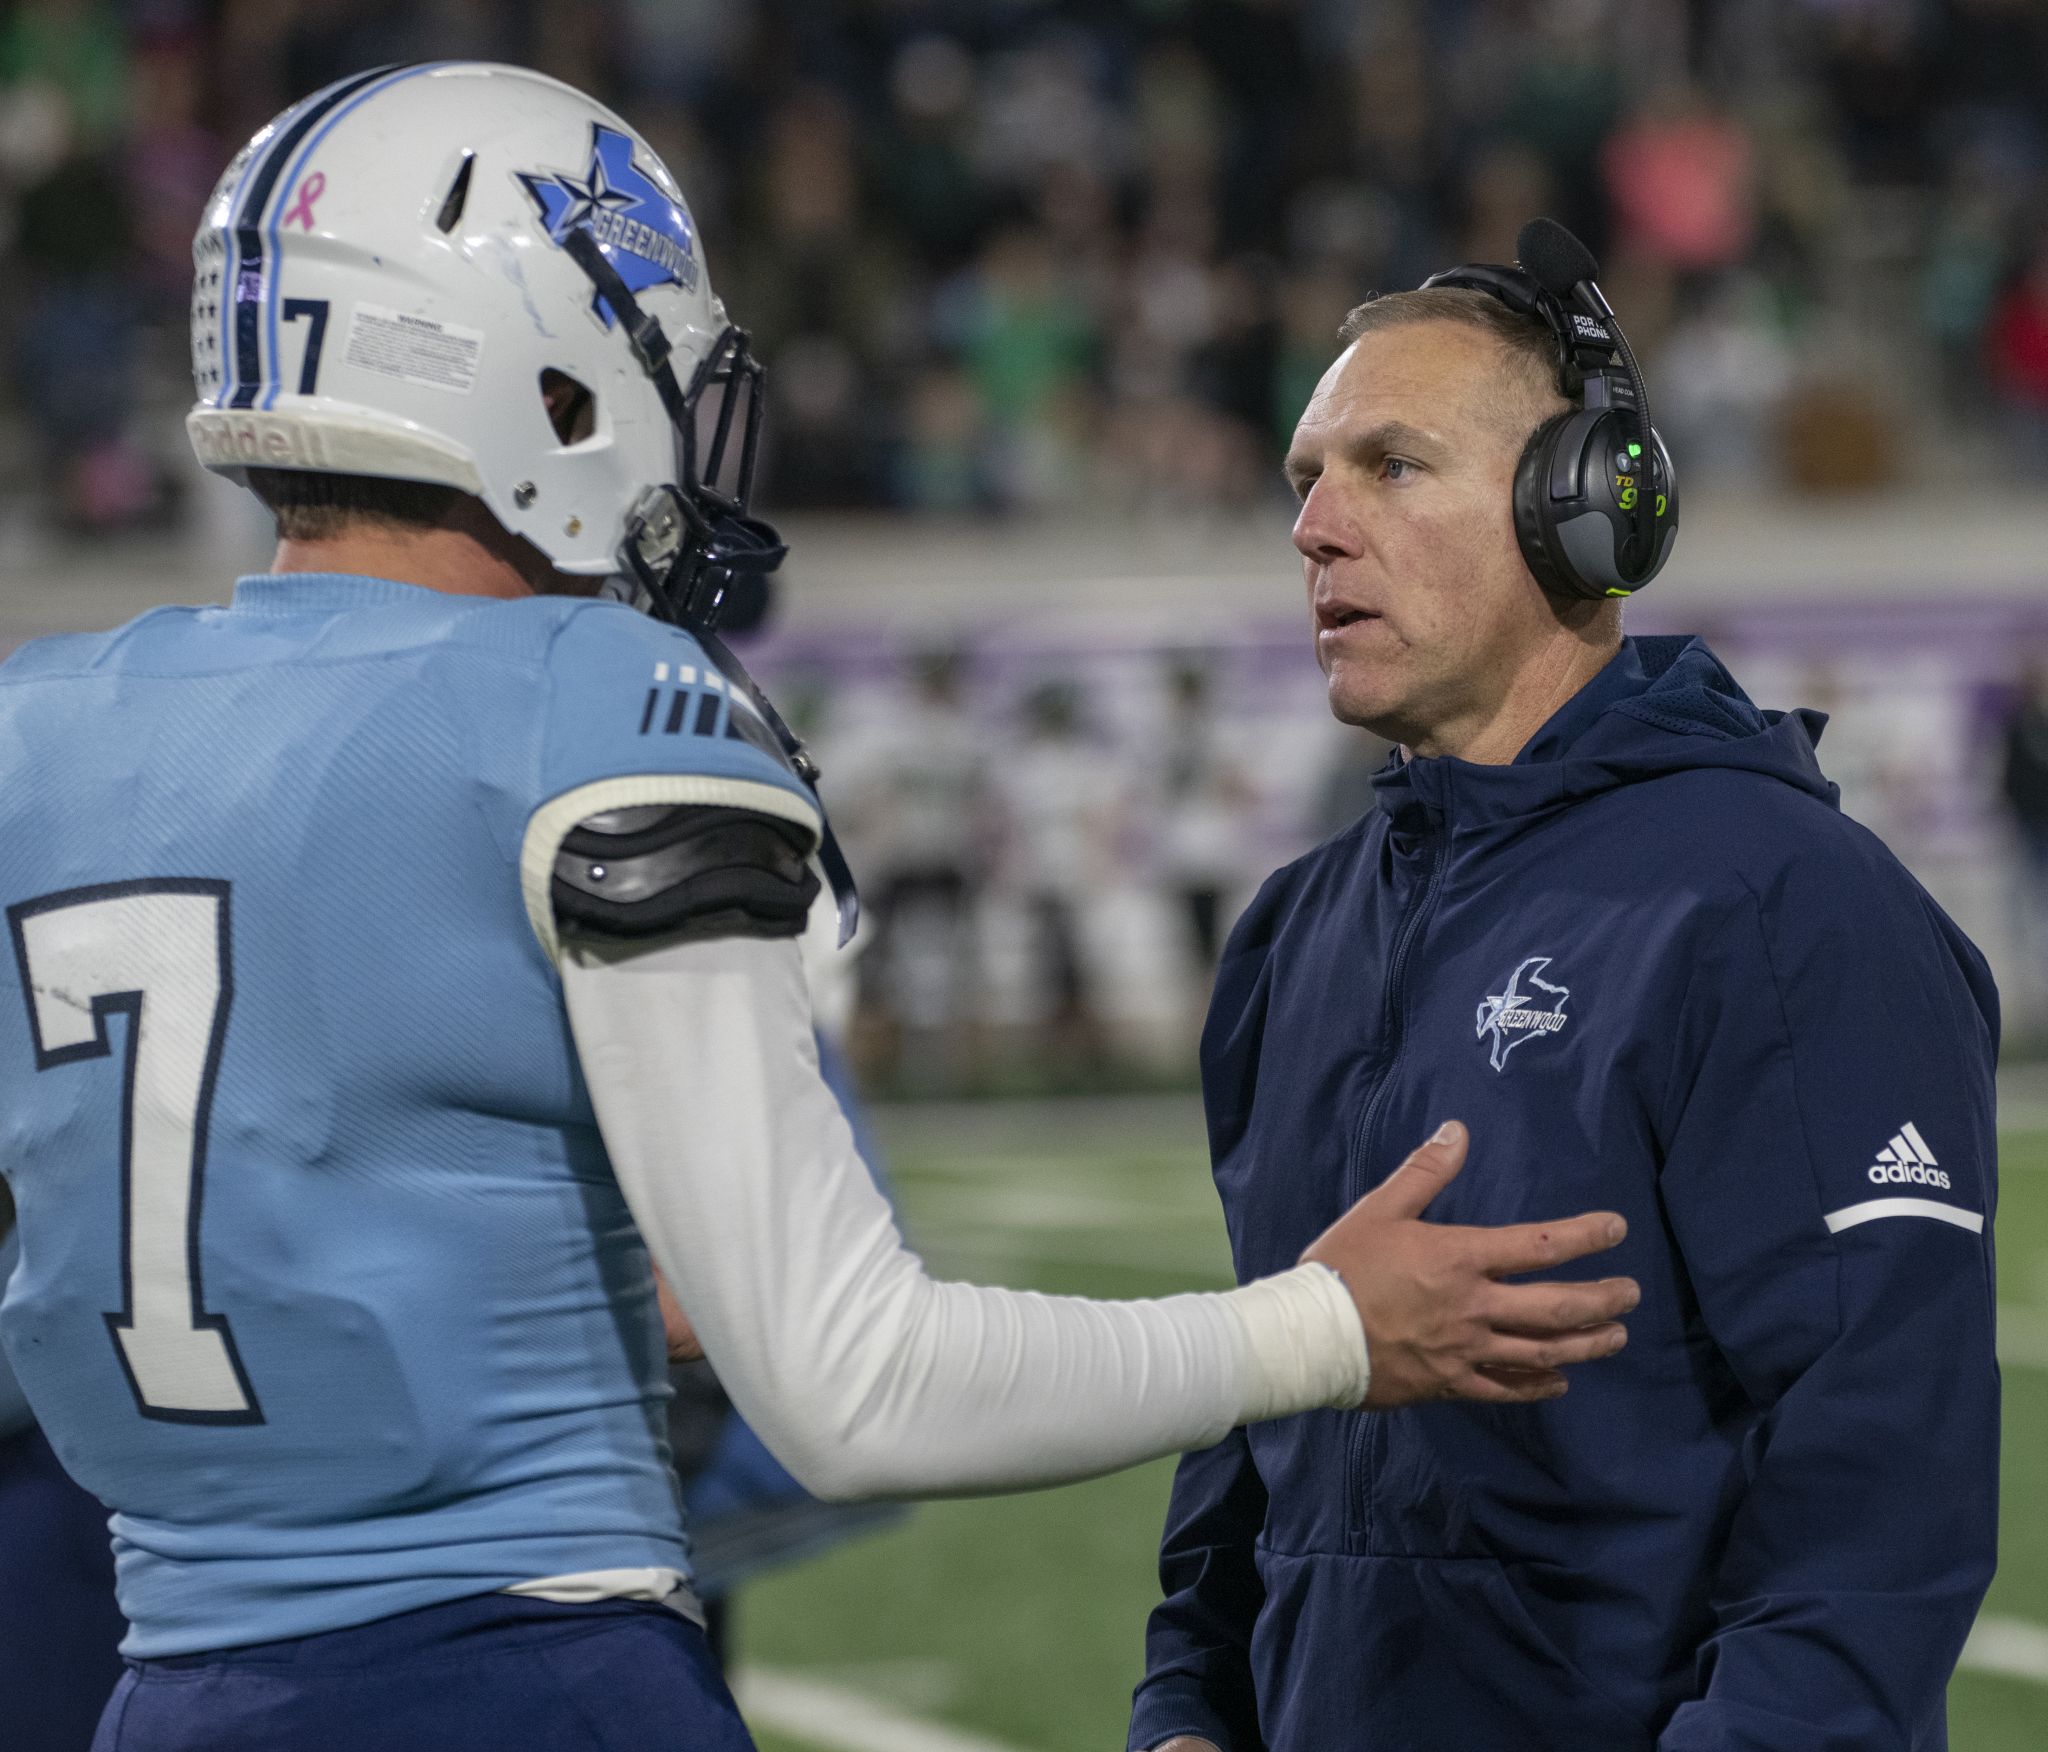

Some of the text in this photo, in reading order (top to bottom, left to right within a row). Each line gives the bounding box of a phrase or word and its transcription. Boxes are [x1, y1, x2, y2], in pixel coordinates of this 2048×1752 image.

[1573, 315, 1603, 329] POR
[1576, 325, 1610, 339] PHONE
[283, 298, 329, 395] 7
[1615, 475, 1634, 487] TD
[1498, 1009, 1568, 1032] GREENWOOD
[6, 876, 267, 1426] 7
[1868, 1160, 1951, 1189] adidas
